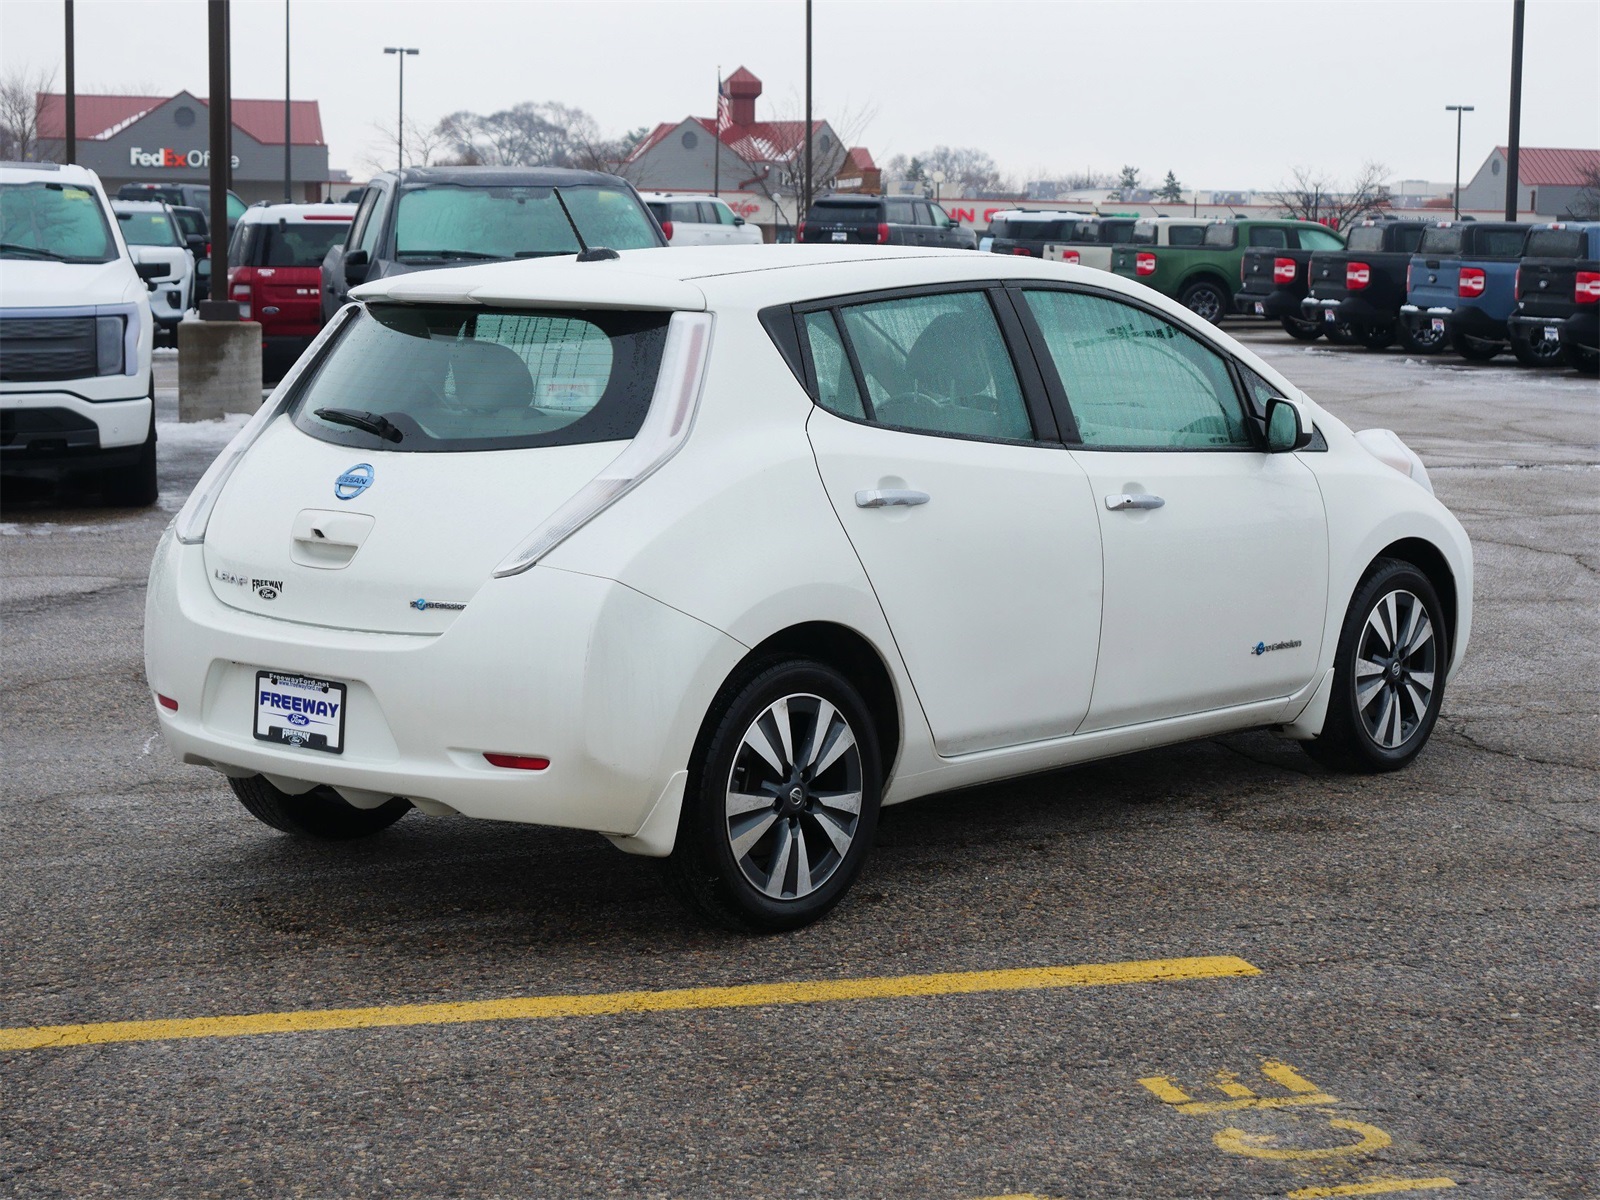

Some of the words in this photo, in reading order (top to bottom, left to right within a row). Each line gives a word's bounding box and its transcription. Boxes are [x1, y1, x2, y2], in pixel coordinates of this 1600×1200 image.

[130, 147, 187, 167] FedEx
[187, 150, 240, 168] Ofe
[252, 578, 283, 593] FREEWAY
[269, 673, 329, 688] FreewayFord.net
[260, 691, 339, 718] FREEWAY
[289, 713, 307, 726] Ford
[282, 728, 310, 742] FREEWAY
